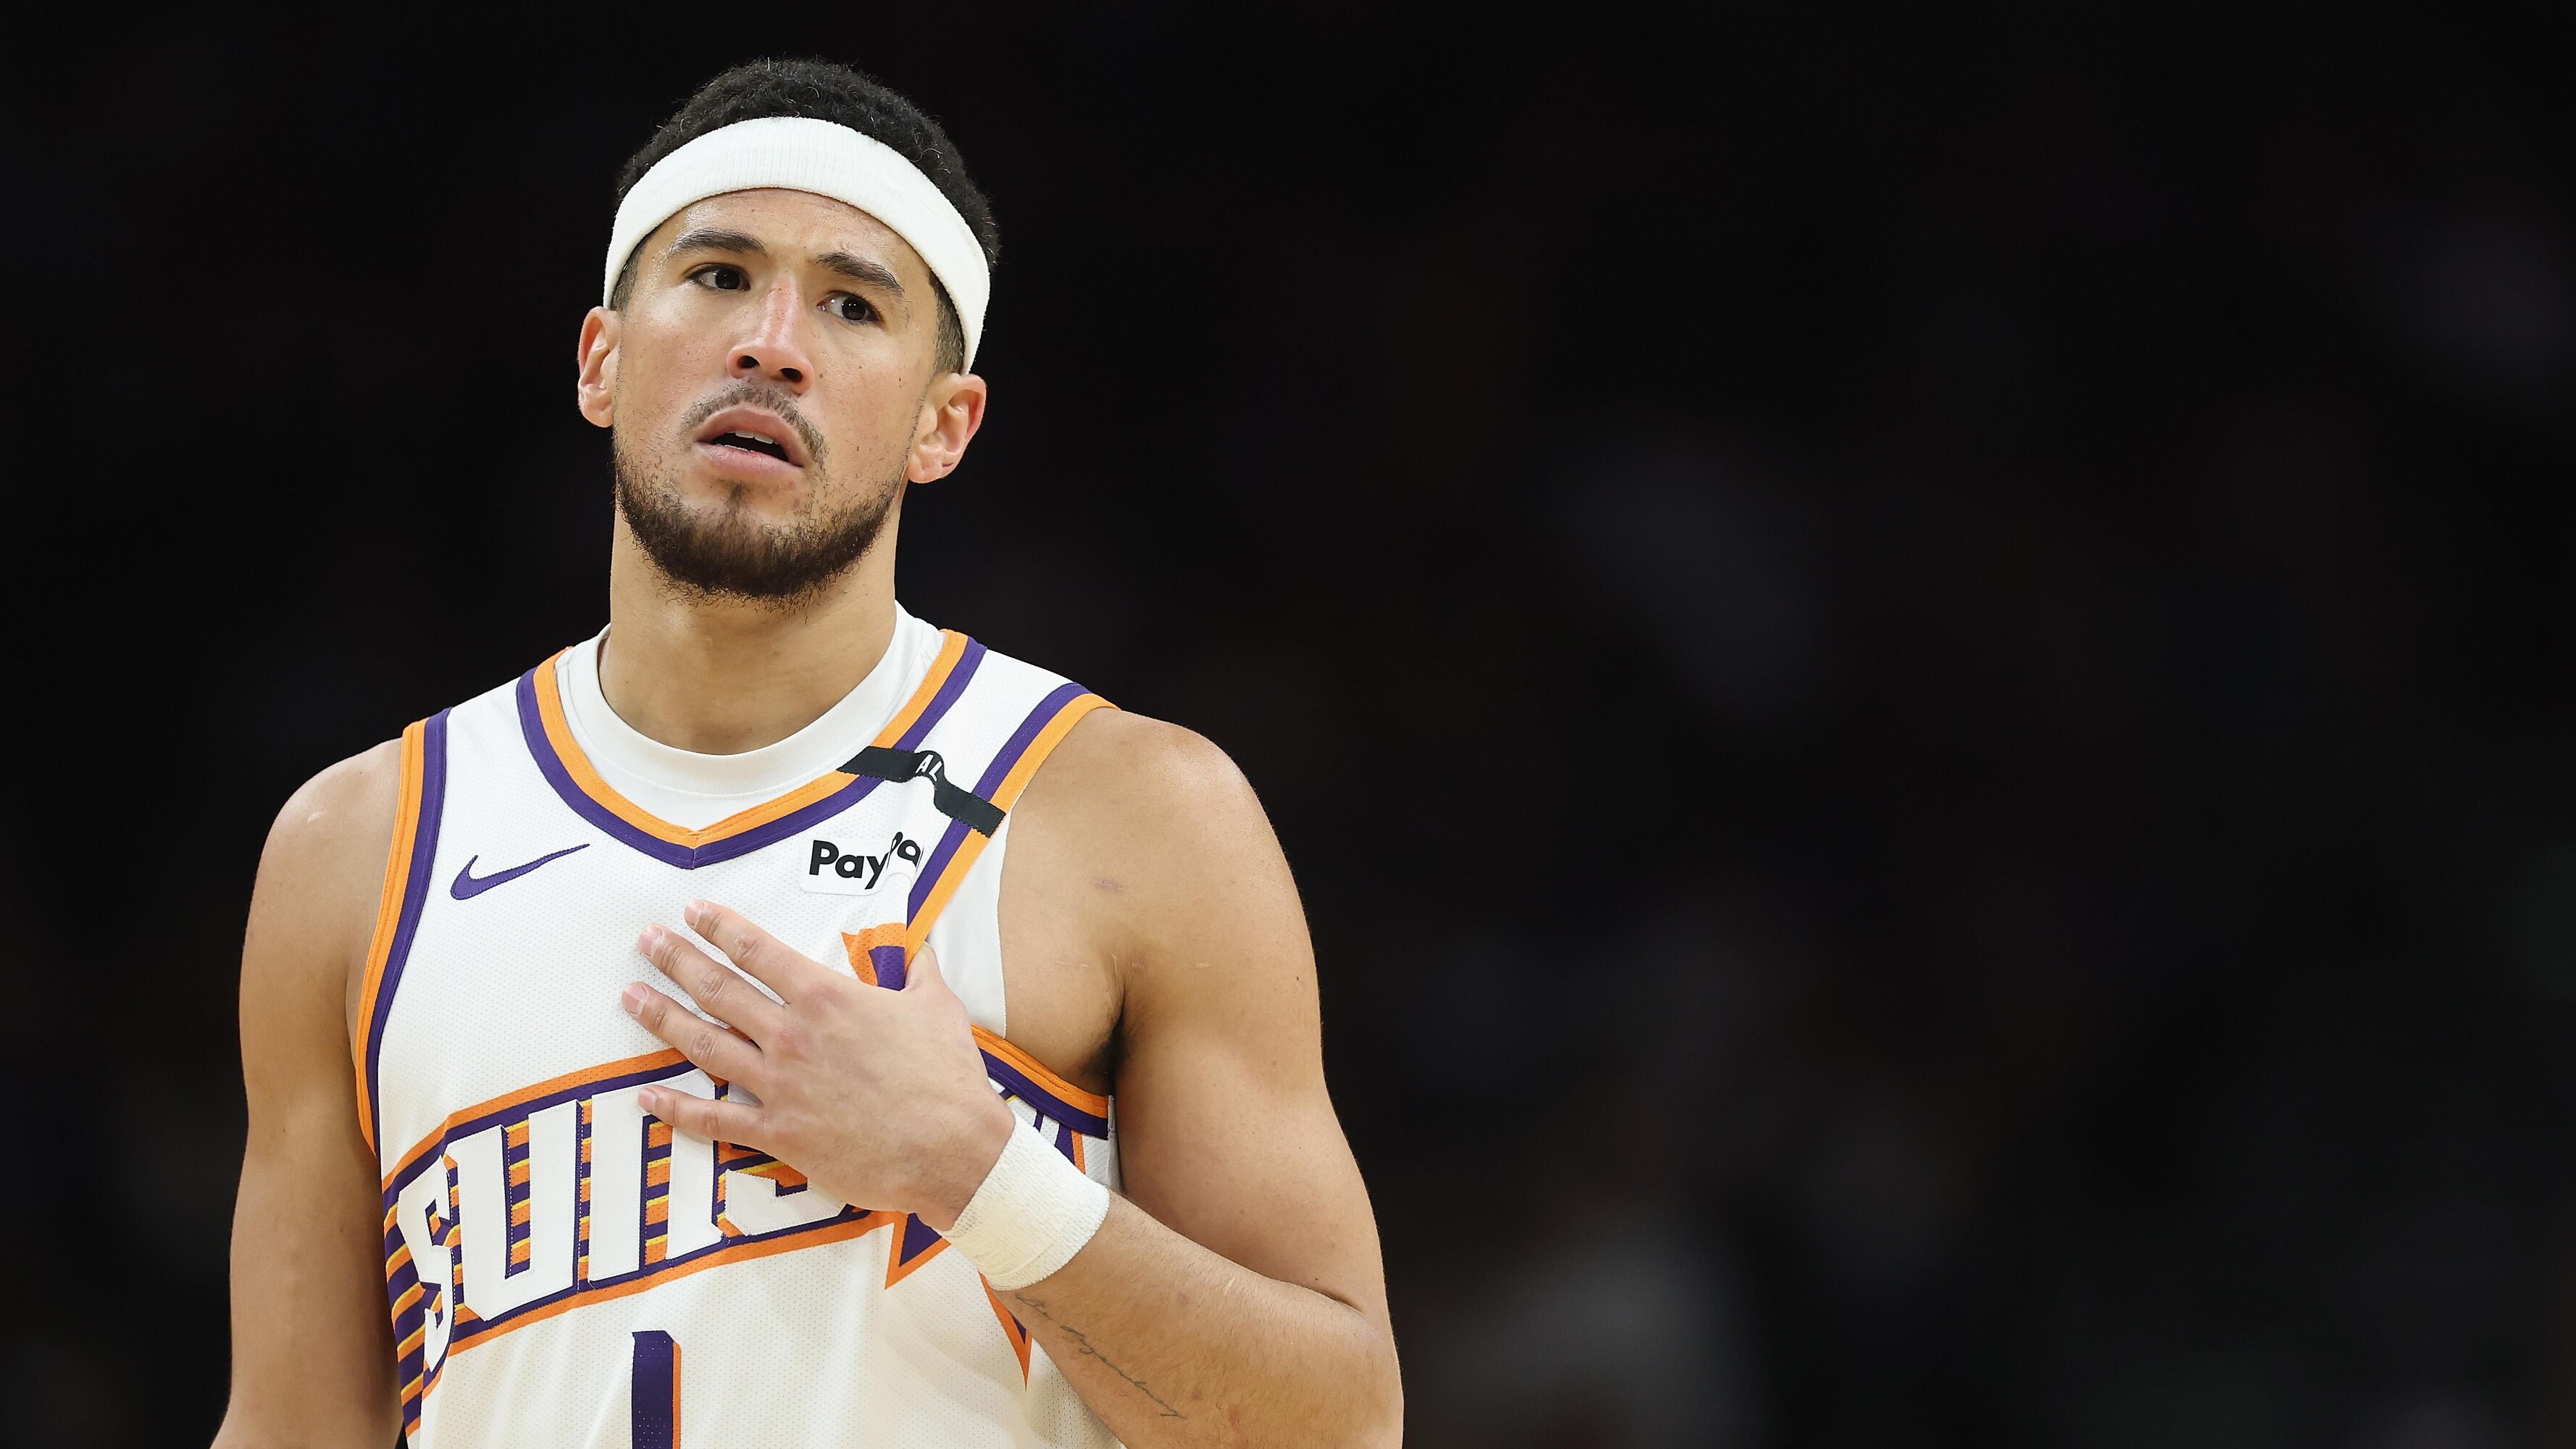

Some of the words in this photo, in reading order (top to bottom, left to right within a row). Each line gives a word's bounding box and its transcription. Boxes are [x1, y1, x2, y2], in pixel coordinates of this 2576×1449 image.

[915, 753, 942, 782] AL
[808, 831, 925, 890] Paya
[631, 1329, 682, 1449] 1
